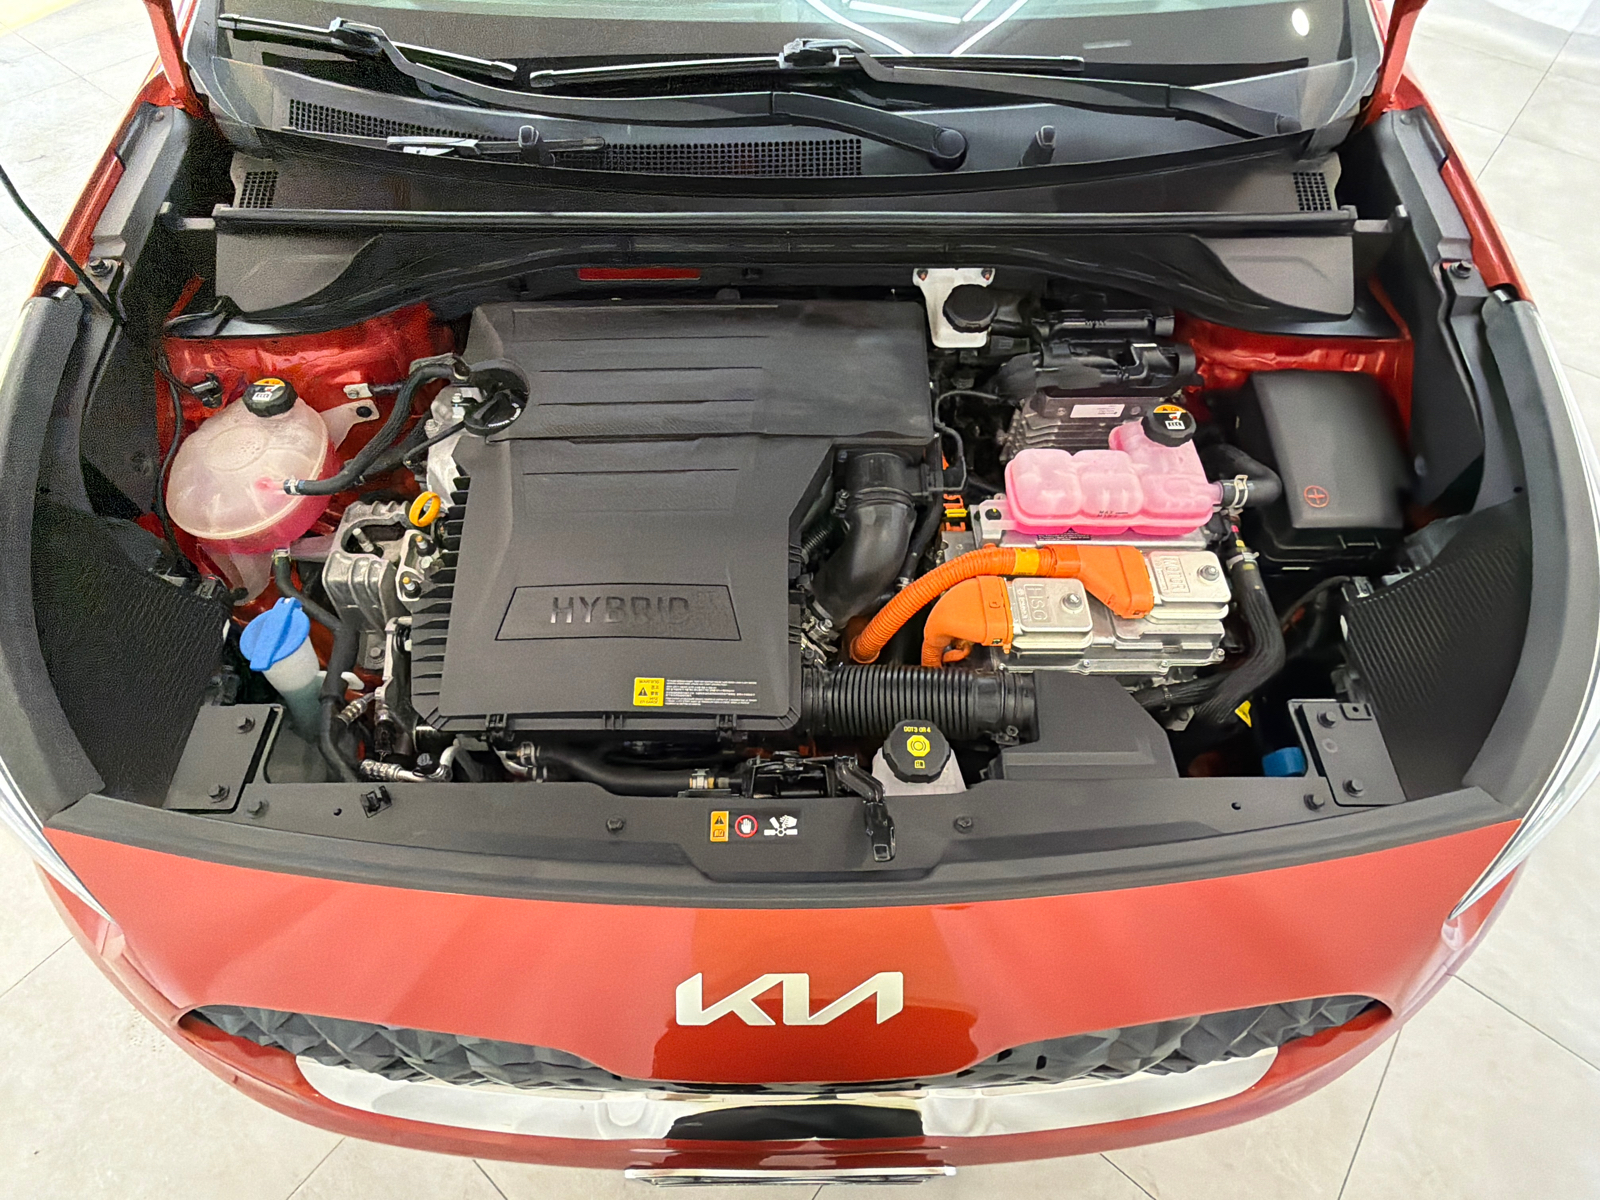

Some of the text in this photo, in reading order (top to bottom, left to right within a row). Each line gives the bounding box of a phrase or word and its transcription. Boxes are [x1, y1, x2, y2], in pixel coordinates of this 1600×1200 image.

[550, 597, 689, 624] HYBRID
[1027, 587, 1048, 620] HSG
[676, 971, 904, 1026] KIA
